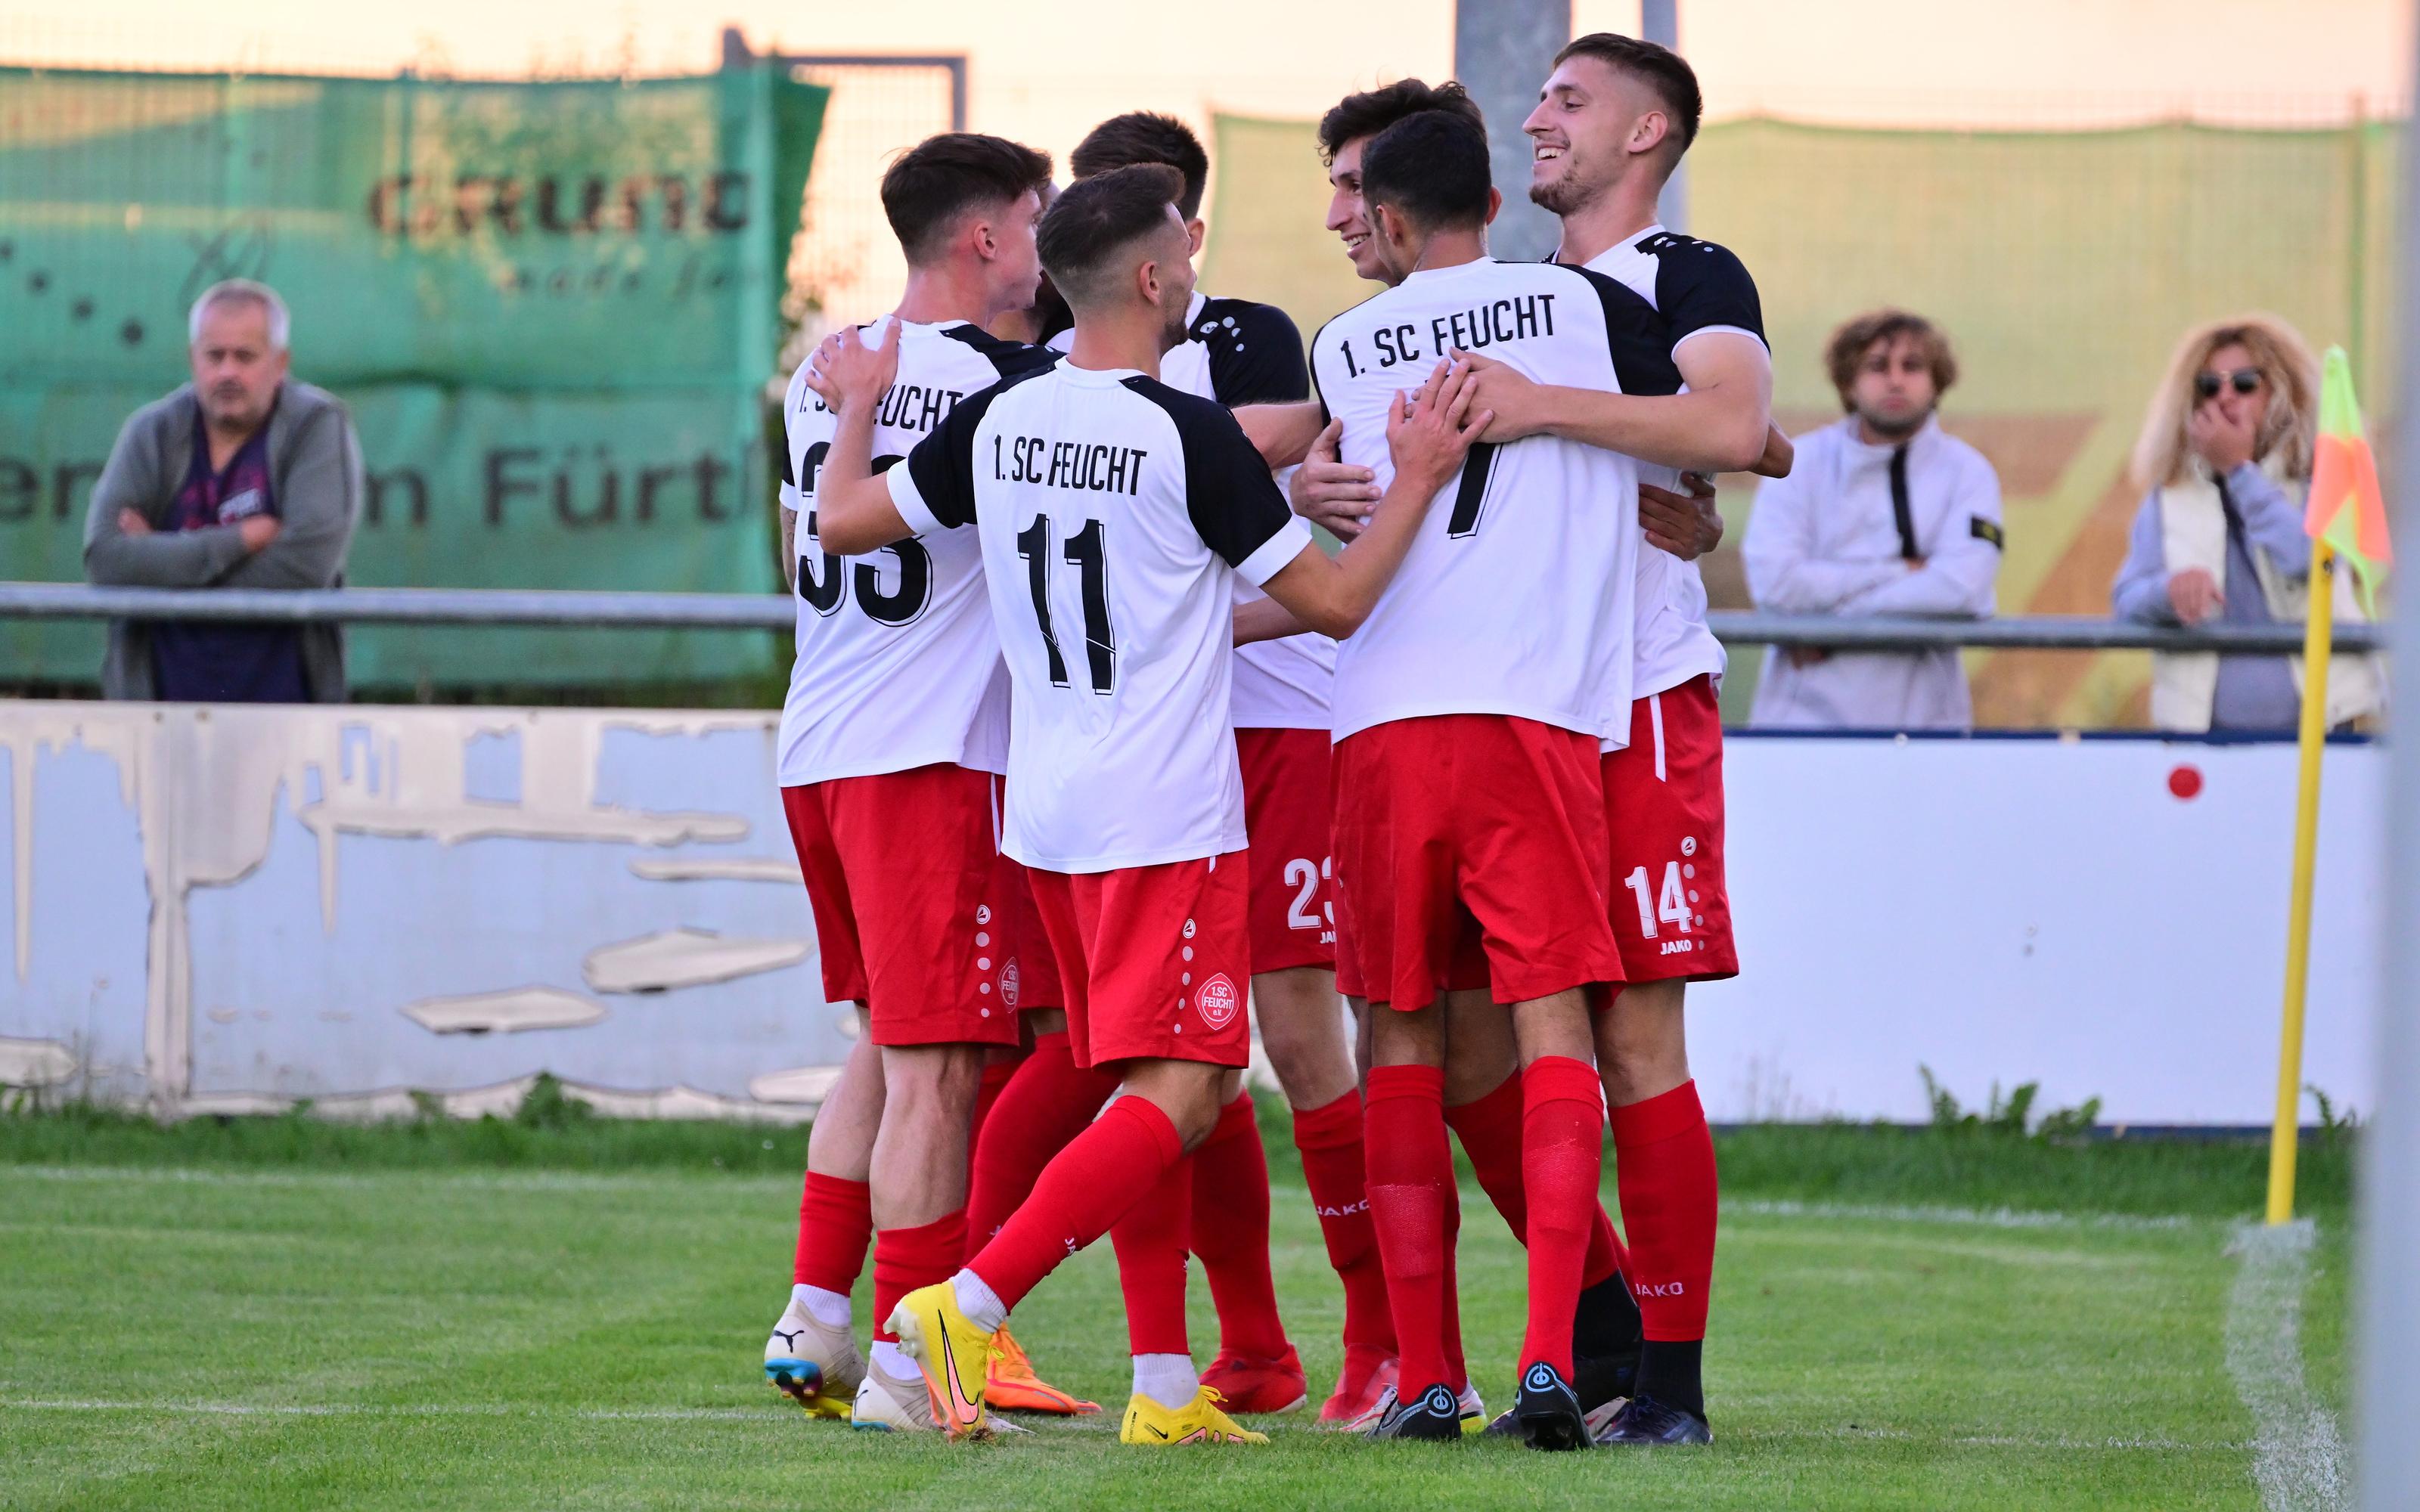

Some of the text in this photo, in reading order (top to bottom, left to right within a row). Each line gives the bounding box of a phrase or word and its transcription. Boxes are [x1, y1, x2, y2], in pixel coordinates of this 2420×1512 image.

[1341, 294, 1555, 379] 1. SC FEUCHT
[994, 434, 1147, 496] 1. SC FEUCHT
[1017, 513, 1116, 696] 11
[1624, 860, 1693, 939] 14
[1660, 939, 1692, 955] JAKO
[1204, 996, 1233, 1009] FEUCHT
[1212, 986, 1227, 997] 1.SC
